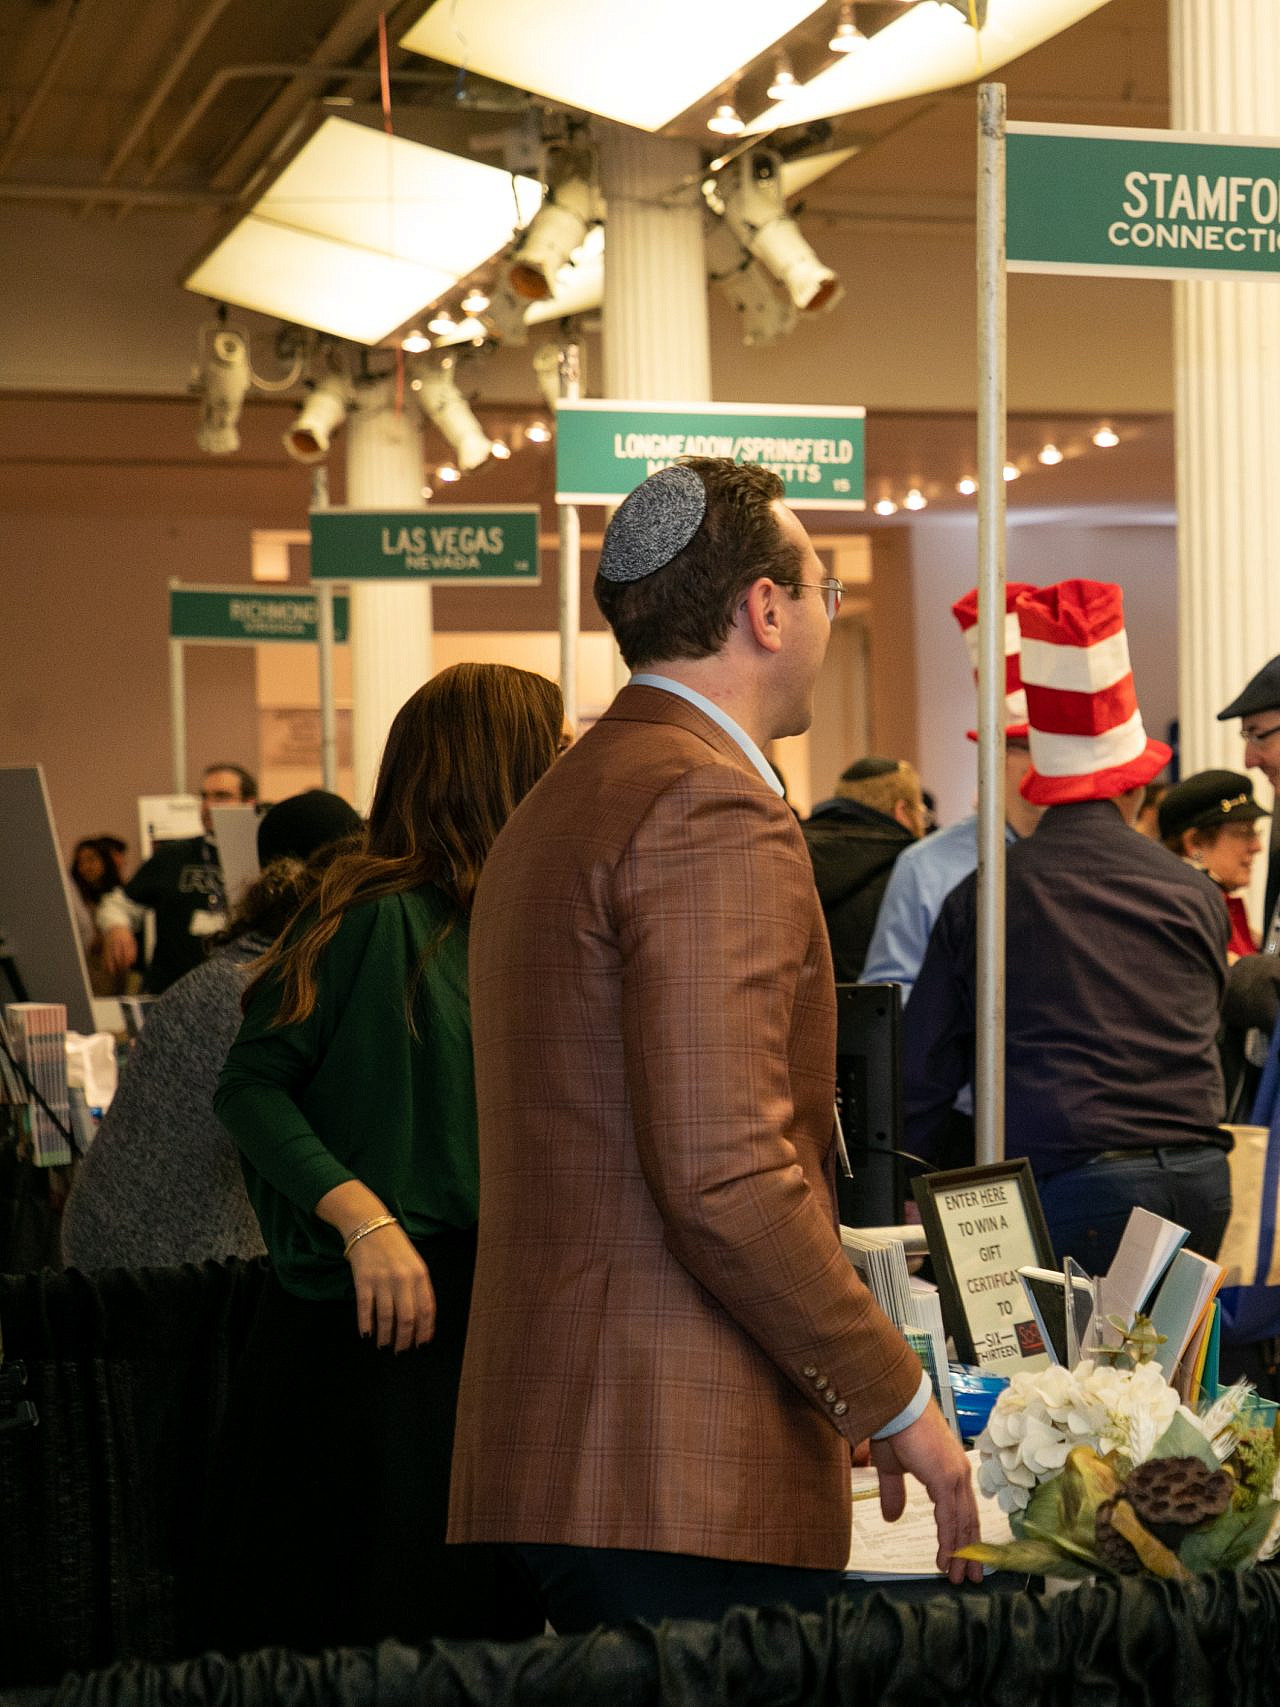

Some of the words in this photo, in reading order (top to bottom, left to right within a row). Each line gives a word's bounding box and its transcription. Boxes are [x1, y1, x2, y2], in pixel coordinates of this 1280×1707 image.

[381, 526, 426, 555] LAS
[430, 526, 504, 556] VEGAS
[405, 554, 481, 571] NEVADA
[945, 1191, 978, 1211] ENTER
[980, 1186, 1007, 1206] HERE
[958, 1221, 974, 1238] TO
[974, 1216, 999, 1235] WIN
[1000, 1215, 1009, 1230] A
[979, 1244, 1002, 1263] GIFT
[966, 1270, 1019, 1295] CERTIFICA
[997, 1300, 1013, 1316] TO
[985, 1331, 1002, 1348] SIX
